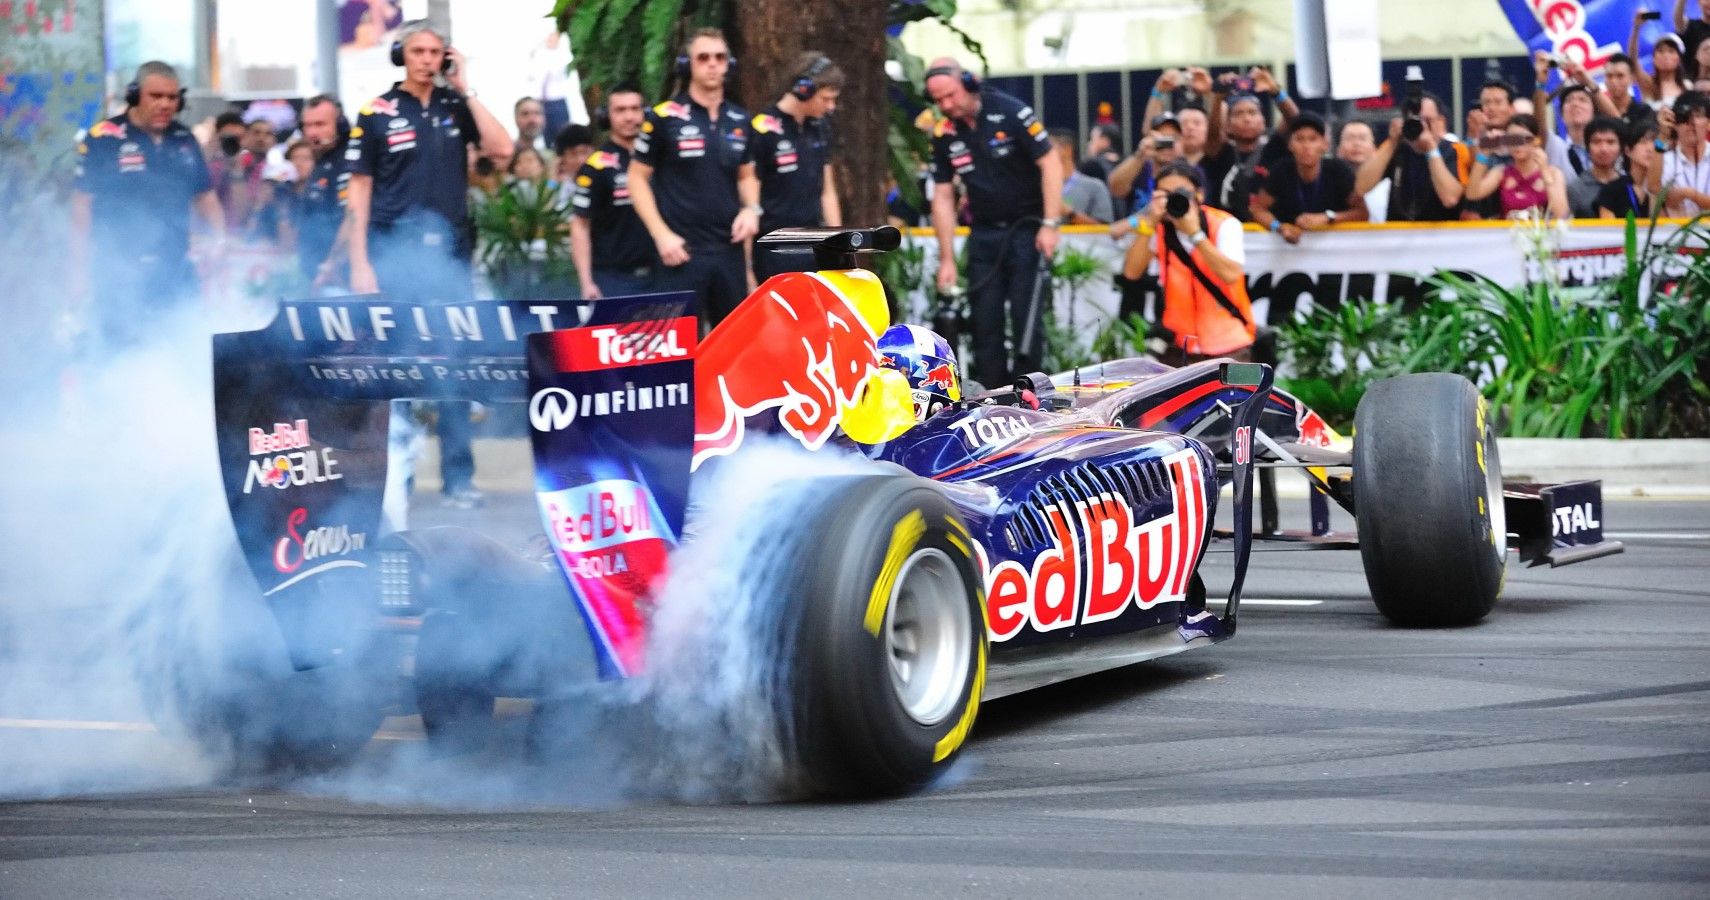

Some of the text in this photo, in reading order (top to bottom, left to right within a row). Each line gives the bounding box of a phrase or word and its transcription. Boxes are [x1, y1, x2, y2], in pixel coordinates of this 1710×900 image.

[1532, 0, 1614, 77] ed
[591, 328, 688, 365] TOTAL
[309, 364, 425, 386] Inspired
[580, 382, 689, 418] INFINITI
[947, 414, 1039, 448] TOTAL
[1235, 425, 1251, 466] 31
[549, 486, 651, 544] Red Bull
[974, 503, 1081, 641] ed
[1076, 449, 1207, 625] Bull
[577, 552, 629, 579] COLA
